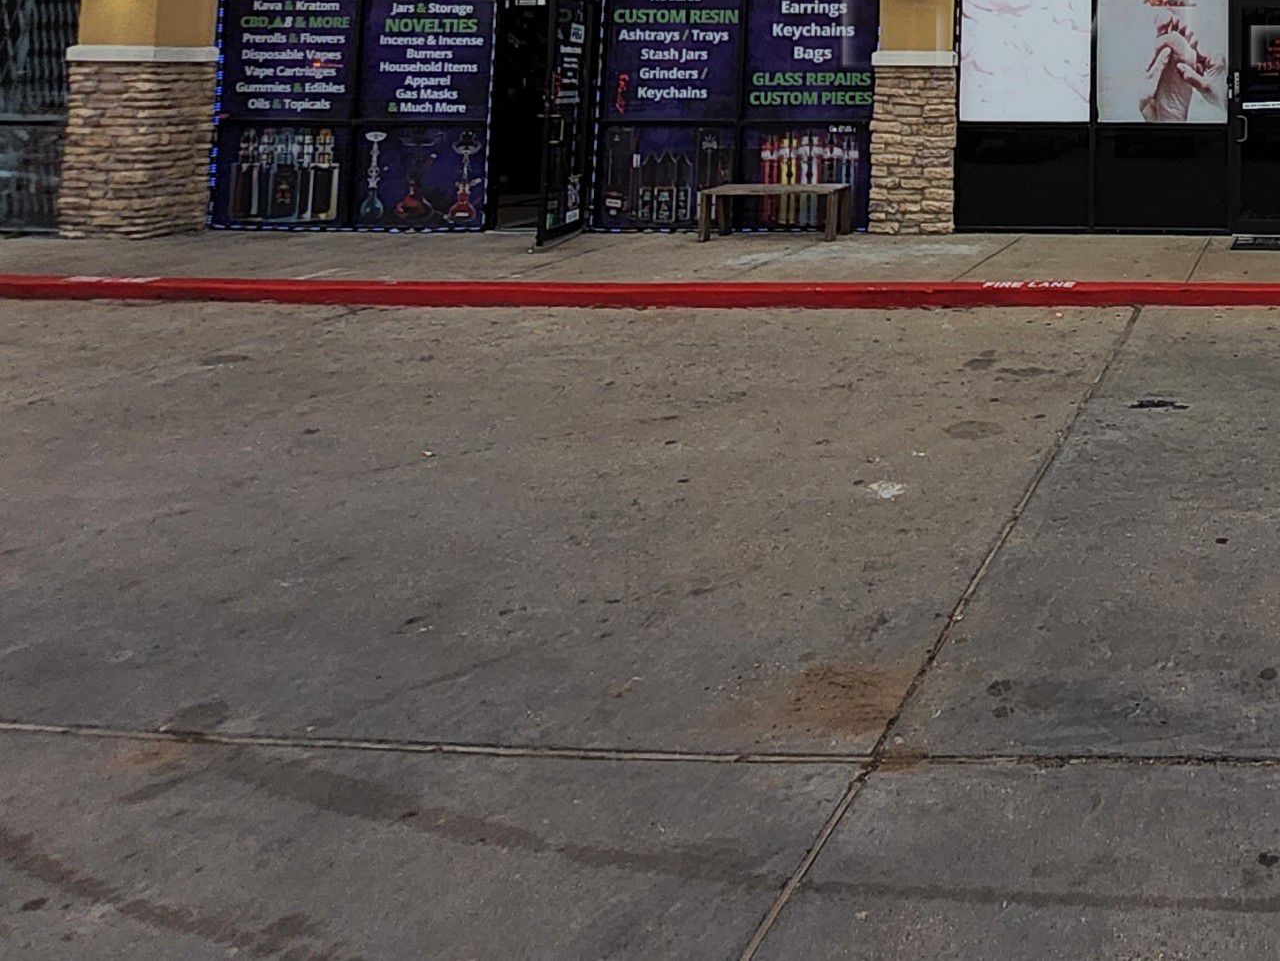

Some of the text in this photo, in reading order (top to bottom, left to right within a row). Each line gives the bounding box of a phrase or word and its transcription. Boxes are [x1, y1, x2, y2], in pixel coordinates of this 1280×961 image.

[253, 0, 282, 10] Kava
[295, 0, 340, 10] Kratom
[390, 2, 415, 16] Jars
[428, 2, 474, 16] Storage
[781, 0, 848, 18] Earrings
[308, 17, 351, 28] MORE
[613, 9, 739, 24] CUSTOM RESIN
[385, 18, 478, 33] NOVELTIES
[772, 22, 855, 41] Keychains
[242, 33, 287, 43] Prerolls
[300, 33, 346, 44] Flowers
[380, 35, 425, 45] Incense
[438, 35, 484, 46] Incense
[618, 28, 680, 44] Ashtrays
[691, 29, 729, 44] Trays
[241, 49, 342, 62] Disposable Vapes
[406, 48, 453, 58] Burners
[640, 48, 708, 63] Stash Jars
[793, 46, 832, 63] Bags
[245, 66, 337, 79] Vape Cartridges
[379, 61, 478, 72] Household Items
[639, 67, 699, 80] Grinders
[752, 72, 872, 86] GLASS REPAIRS
[236, 82, 291, 93] Gummies
[304, 82, 346, 93] Edibles
[404, 75, 451, 88] Apparel
[395, 88, 458, 99] Gas Masks
[637, 86, 708, 102] Keychains
[749, 91, 874, 105] CUSTOM PIECES
[247, 98, 271, 109] Oils
[283, 98, 331, 112] Topicals
[400, 102, 433, 112] Much
[435, 102, 466, 113] More
